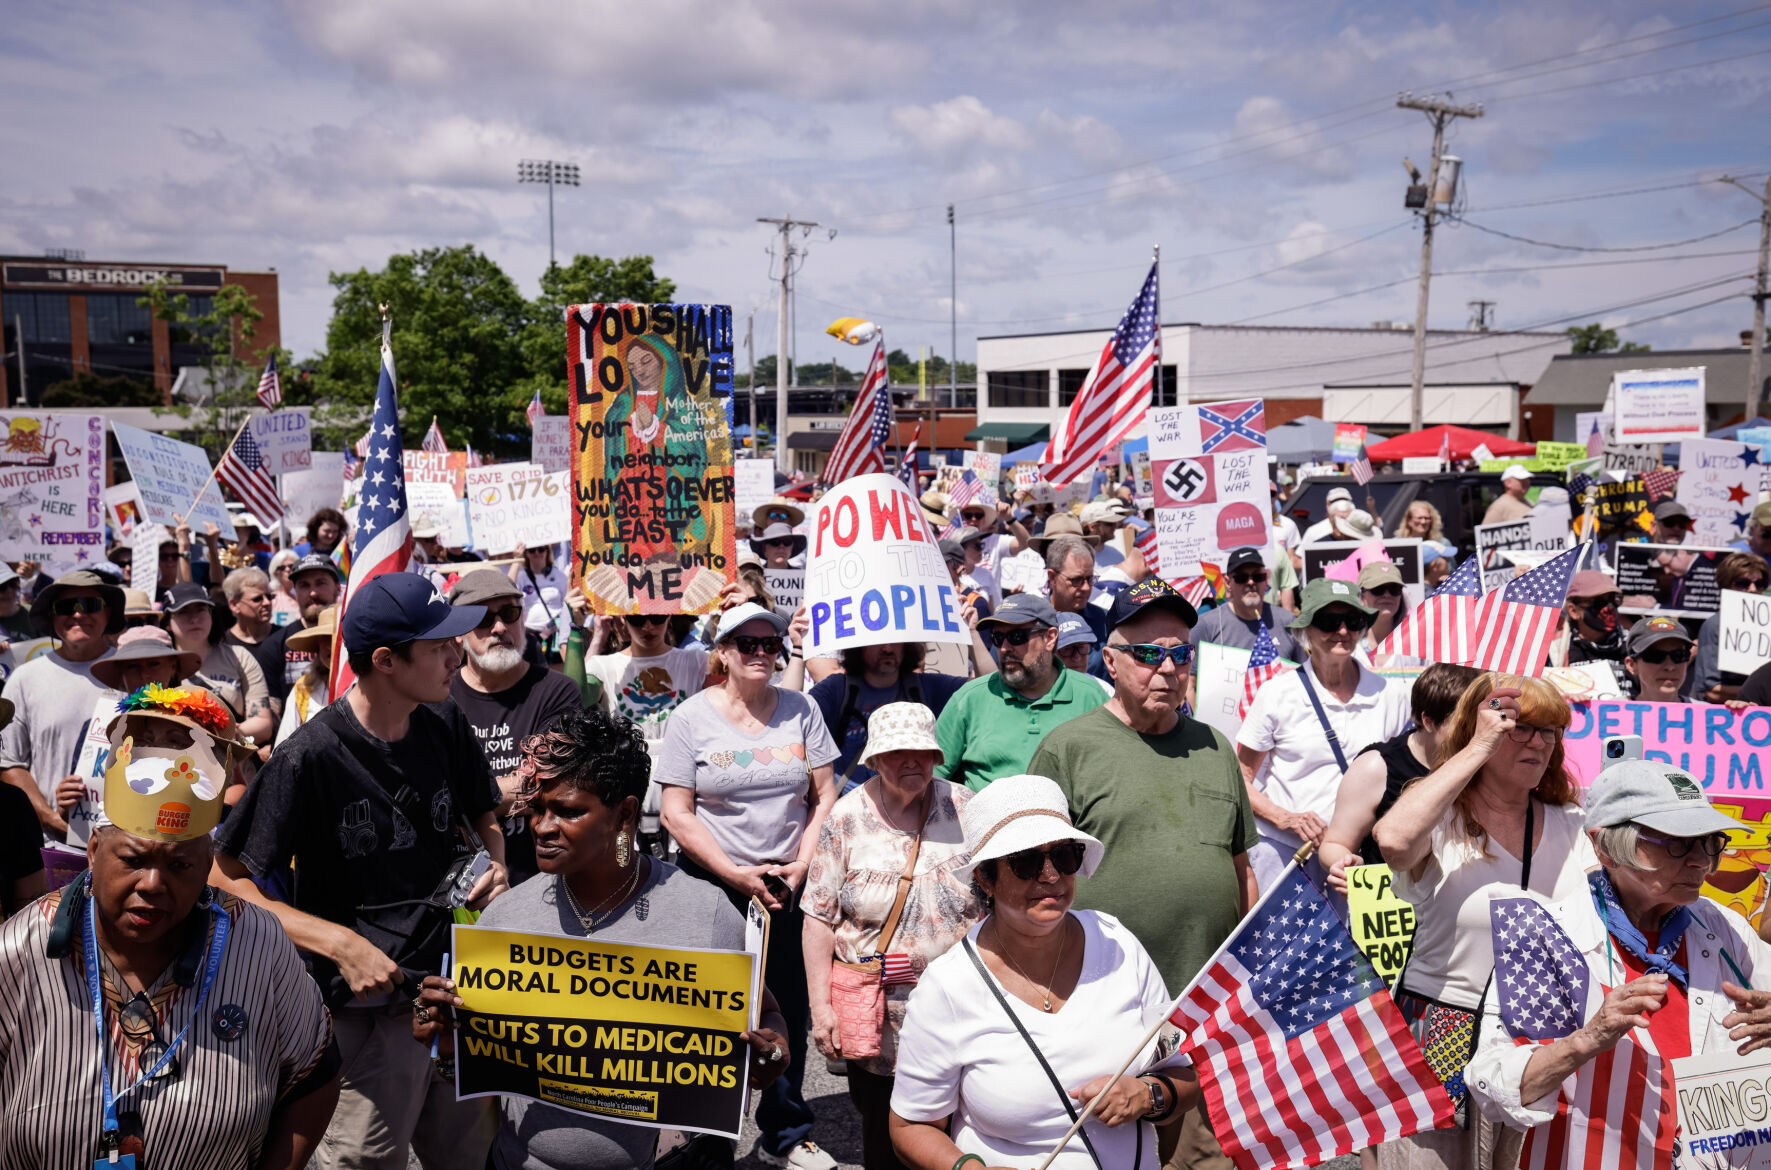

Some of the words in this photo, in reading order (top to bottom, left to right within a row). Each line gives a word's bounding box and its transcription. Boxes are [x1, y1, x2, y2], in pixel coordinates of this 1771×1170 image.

[66, 269, 169, 285] BEDROCK
[572, 307, 647, 359] YOU
[651, 306, 733, 358] SHALL
[665, 397, 713, 413] Mother
[256, 413, 307, 436] UNITED
[681, 412, 693, 425] of
[694, 413, 716, 425] the
[1155, 411, 1182, 423] LOST
[1160, 419, 1179, 430] THE
[576, 420, 632, 452] your
[664, 425, 725, 443] Americas
[1156, 432, 1182, 443] WAR
[404, 451, 451, 470] FIGHT
[1222, 455, 1257, 469] LOST
[468, 471, 503, 485] SAVE
[1227, 467, 1250, 481] THE
[49, 485, 60, 496] IS
[508, 475, 559, 501] 1776
[1224, 481, 1251, 493] WAR
[41, 499, 77, 516] HERE
[576, 503, 610, 526] you
[1592, 499, 1648, 517] TRUMP
[1158, 522, 1195, 534] NEXT
[1225, 517, 1255, 531] MAGA
[41, 532, 102, 545] REMEMBER
[1481, 525, 1531, 547] HANDS
[576, 549, 614, 577] you
[617, 543, 643, 568] do
[680, 543, 726, 570] unto
[815, 551, 865, 597] TO
[887, 544, 947, 580] THE
[627, 568, 683, 600] ME
[811, 585, 960, 646] PEOPLE
[1742, 598, 1770, 626] NO
[1725, 627, 1752, 653] NO
[490, 722, 510, 738] Job
[713, 773, 735, 788] Be
[157, 817, 189, 828] KING
[158, 809, 191, 820] BURGER
[207, 916, 228, 972] VOLUNTEER
[509, 943, 635, 975] BUDGETS
[643, 959, 697, 983] ARE
[458, 966, 560, 994] MORAL
[570, 975, 745, 1011] DOCUMENTS
[469, 1016, 540, 1045] CUTS
[547, 1024, 588, 1048] TO
[594, 1026, 733, 1057] MEDICAID
[464, 1036, 528, 1068] WILL
[536, 1052, 593, 1079] KILL
[601, 1058, 737, 1088] MILLIONS
[547, 1089, 561, 1098] North
[562, 1093, 584, 1103] Carolina
[584, 1098, 597, 1106] Poor
[597, 1100, 620, 1109] People's
[621, 1102, 649, 1113] Campaign
[1689, 1129, 1757, 1156] FREEDOM
